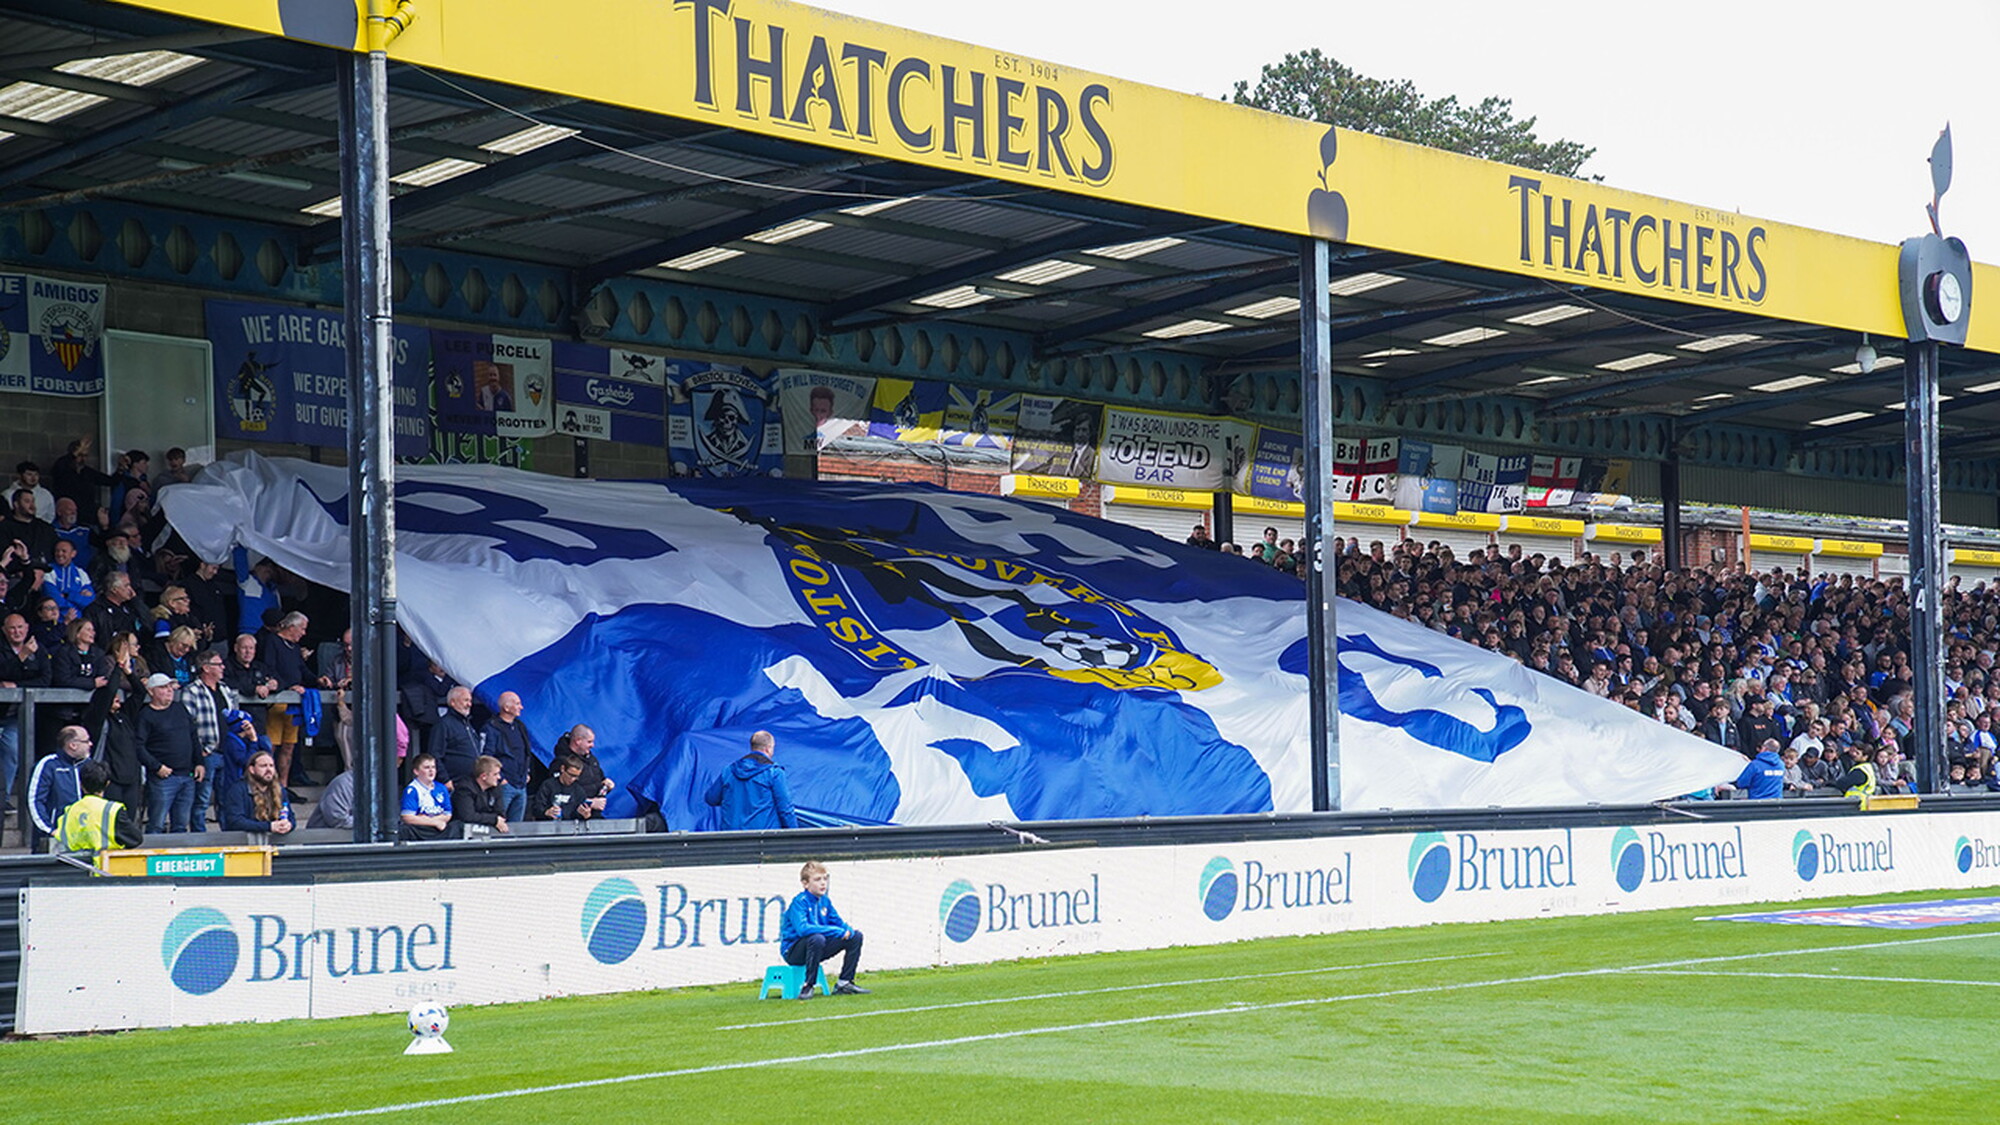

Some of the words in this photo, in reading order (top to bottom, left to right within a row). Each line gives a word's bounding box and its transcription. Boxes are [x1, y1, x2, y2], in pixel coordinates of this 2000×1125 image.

[994, 54, 1021, 75] EST.
[1029, 63, 1059, 82] 1904
[674, 0, 1116, 188] THATCHERS
[1508, 174, 1768, 307] THATCHERS
[33, 282, 99, 304] AMIGOS
[241, 315, 273, 344] WE
[278, 314, 313, 344] ARE
[445, 339, 472, 353] LEE
[476, 342, 541, 360] PURCELL
[33, 376, 105, 394] FOREVER
[293, 371, 312, 393] WE
[314, 375, 347, 398] EXPE
[691, 372, 726, 385] BRISTOL
[295, 403, 316, 425] BUT
[319, 406, 347, 428] GIVE
[484, 416, 547, 429] FORGOTTEN
[1142, 418, 1167, 435] BORN
[1168, 420, 1200, 438] UNDER
[1201, 423, 1221, 440] THE
[1109, 434, 1158, 467] TOTE
[1158, 441, 1210, 470] END
[1467, 454, 1480, 468] WE
[1134, 466, 1175, 483] BAR
[1255, 464, 1272, 475] TOTE
[1272, 467, 1287, 478] END
[1256, 475, 1282, 487] LEGEND
[1476, 468, 1495, 483] ARE
[1027, 477, 1068, 492] THATCHERS
[1493, 485, 1509, 499] THE
[1352, 505, 1386, 518] THATCHERS
[1503, 495, 1521, 509] GAS
[1531, 518, 1562, 531] THATCHERS
[1615, 527, 1643, 538] THATCHERS
[1313, 541, 1323, 573] 3
[1915, 588, 1926, 612] 4
[1455, 828, 1577, 892] Brunel
[1648, 826, 1748, 883] Brunel
[1820, 828, 1895, 875] Brunel
[1974, 838, 2000, 868] Bru
[155, 857, 218, 874] EMERGENCY
[1241, 852, 1353, 912] Brunel
[984, 873, 1101, 934] Brunel
[652, 883, 786, 951] Brun
[245, 902, 457, 984] Brunel
